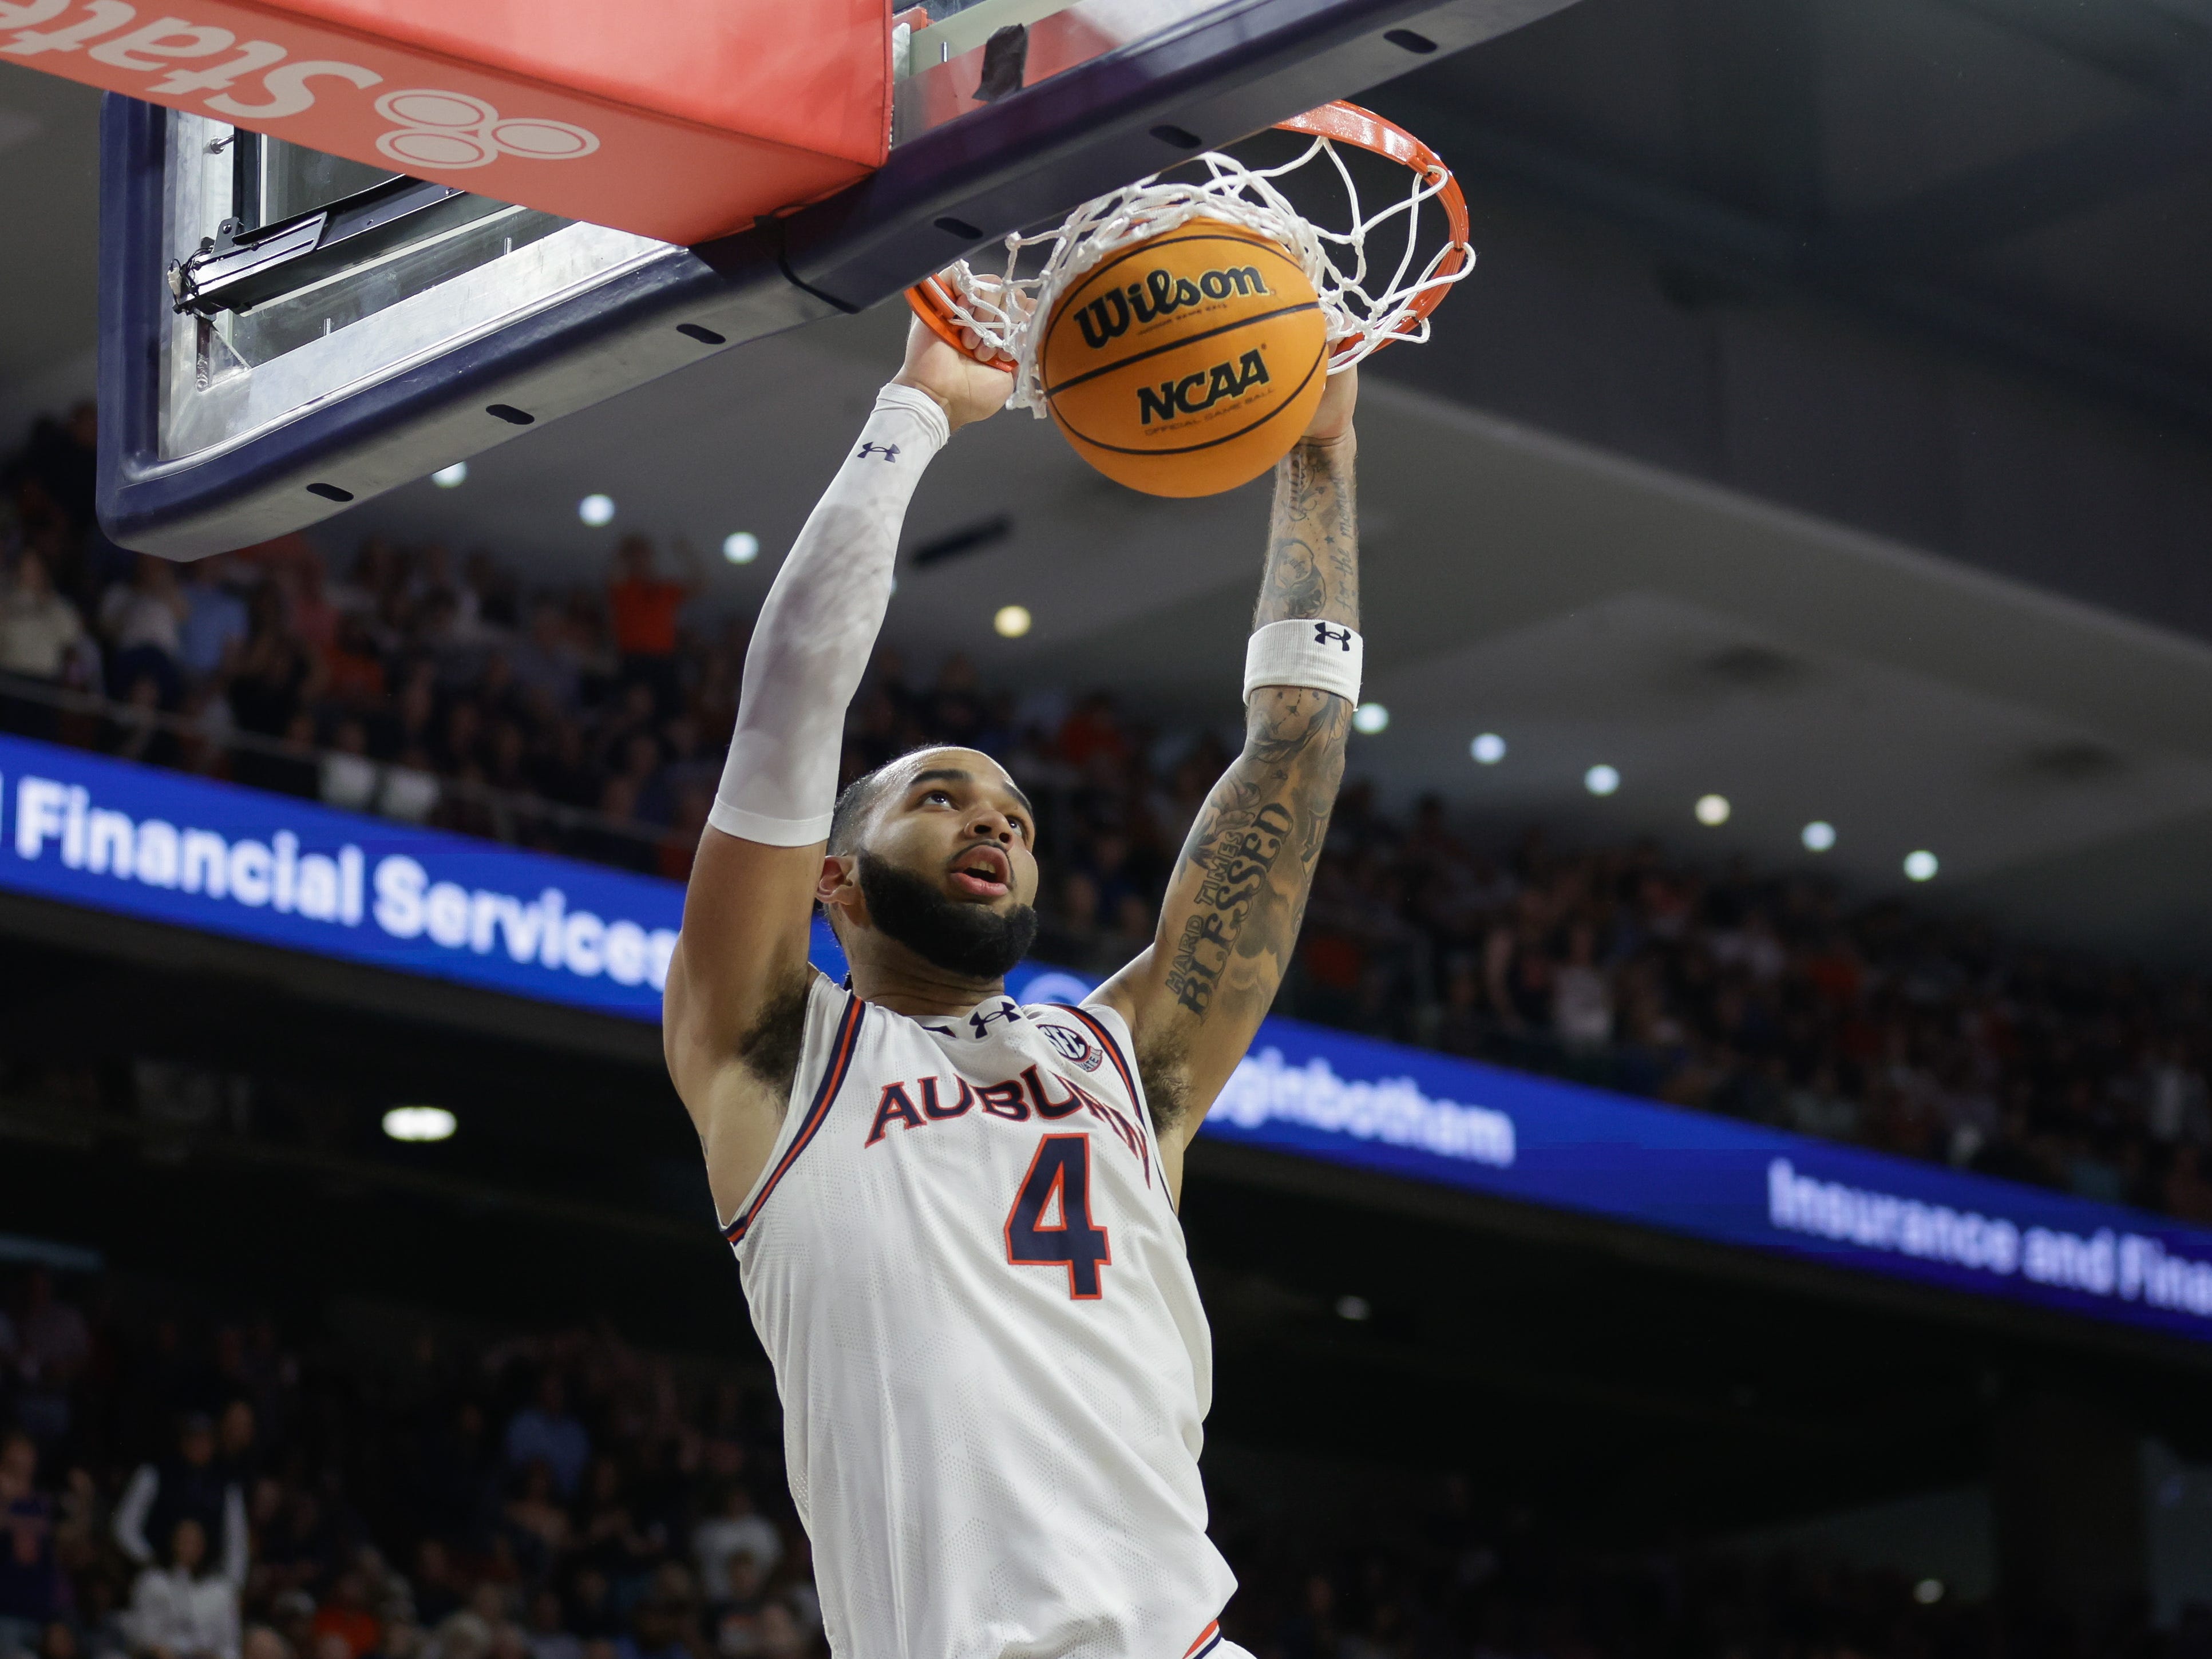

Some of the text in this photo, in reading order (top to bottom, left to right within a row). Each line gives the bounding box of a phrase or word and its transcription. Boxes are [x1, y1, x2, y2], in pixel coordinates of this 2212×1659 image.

[1073, 265, 1271, 349] Wilson
[1137, 347, 1271, 425] NCAA
[15, 774, 365, 927] Financial
[1165, 832, 1244, 995] HARD TIMES
[1178, 803, 1293, 1021] BLESSED
[1004, 1133, 1111, 1300] 4
[1767, 1157, 2020, 1275] Insurance
[2022, 1225, 2116, 1296] and
